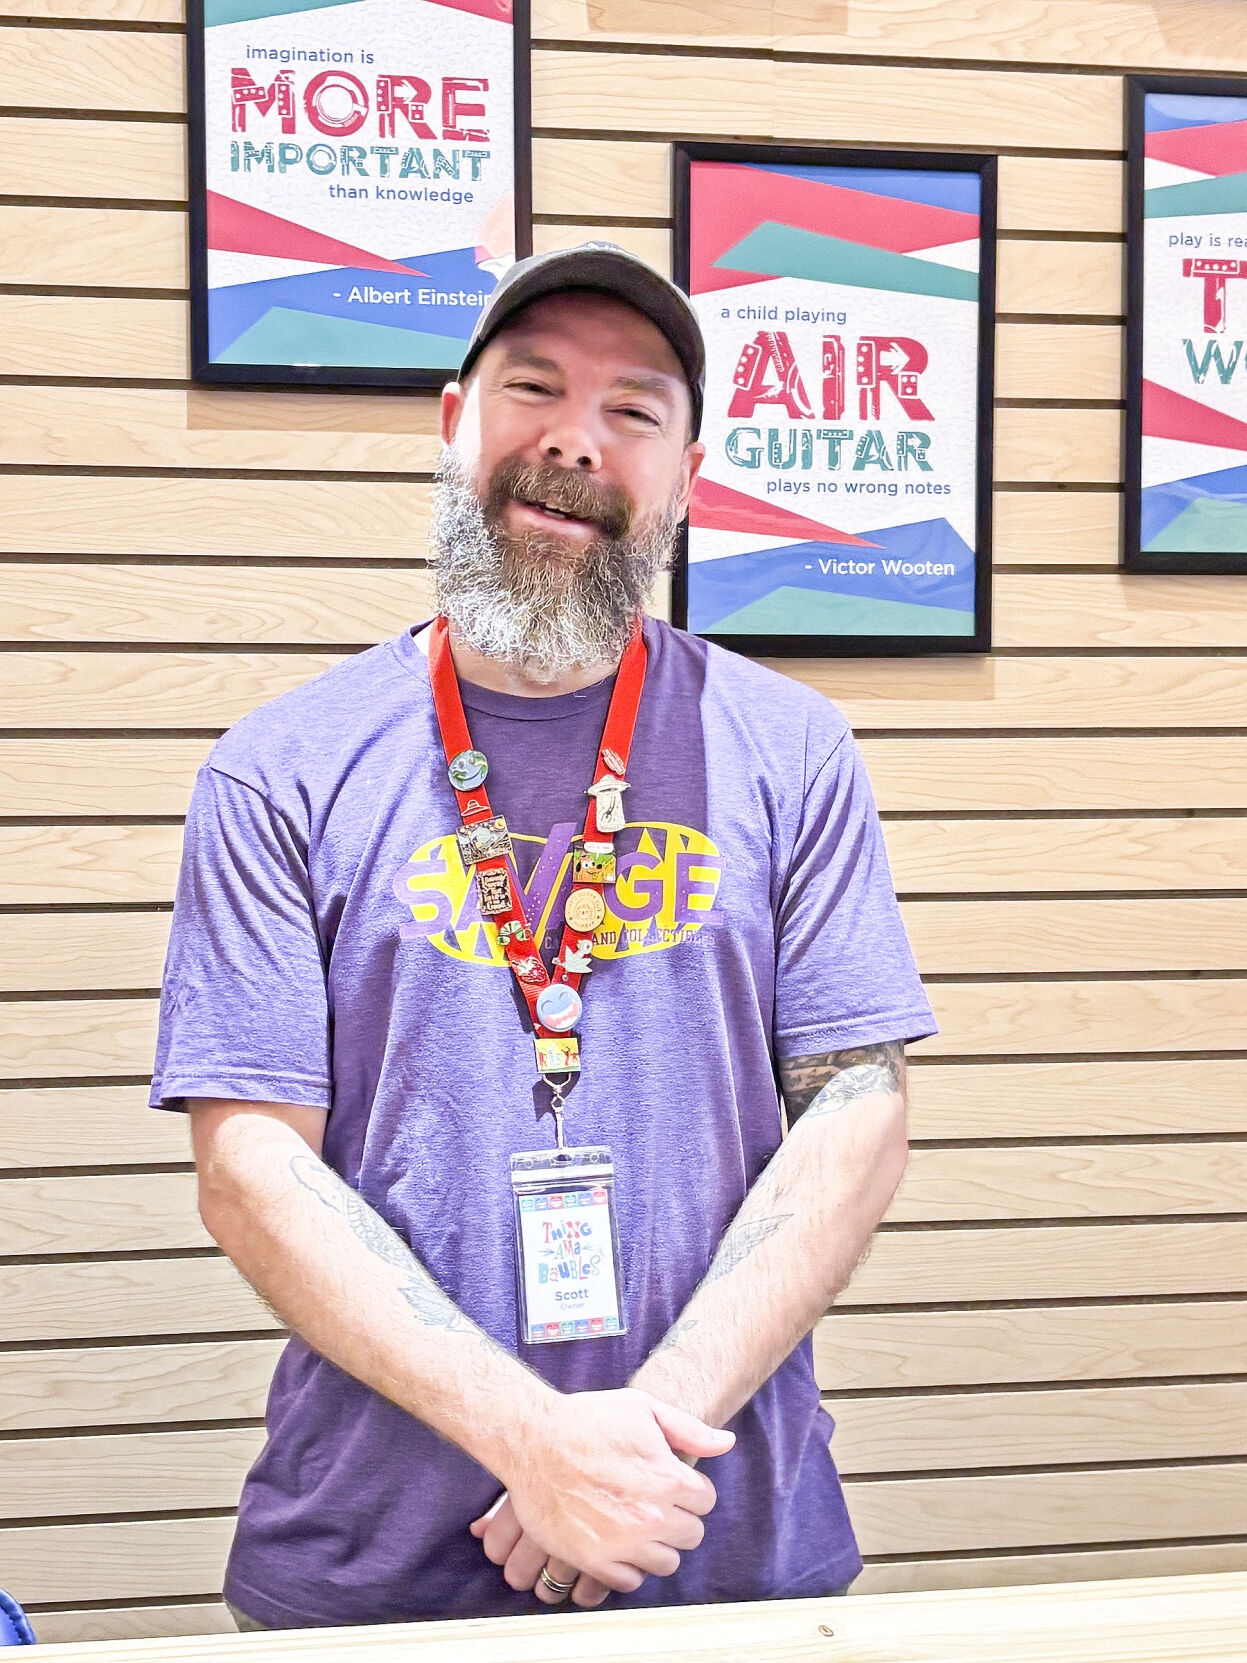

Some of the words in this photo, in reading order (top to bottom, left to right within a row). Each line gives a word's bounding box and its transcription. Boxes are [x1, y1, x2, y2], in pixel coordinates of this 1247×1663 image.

[246, 45, 353, 64] imagination
[361, 49, 375, 65] is
[230, 67, 490, 142] MORE
[230, 140, 491, 181] IMPORTANT
[329, 184, 369, 199] than
[376, 185, 474, 204] knowledge
[1169, 232, 1203, 248] play
[1209, 233, 1221, 247] is
[348, 286, 412, 305] Albert
[720, 308, 731, 319] a
[737, 306, 778, 321] child
[785, 307, 847, 324] playing
[1181, 338, 1247, 385] W
[727, 330, 936, 421] AIR
[725, 426, 934, 471] GUITAR
[767, 478, 811, 494] plays
[817, 482, 838, 493] no
[845, 482, 898, 496] wrong
[905, 481, 952, 495] notes
[818, 558, 876, 575] Victor
[881, 559, 955, 576] Wooten
[392, 822, 727, 946] SAVGE
[591, 930, 616, 945] AND
[555, 1289, 589, 1301] Scott
